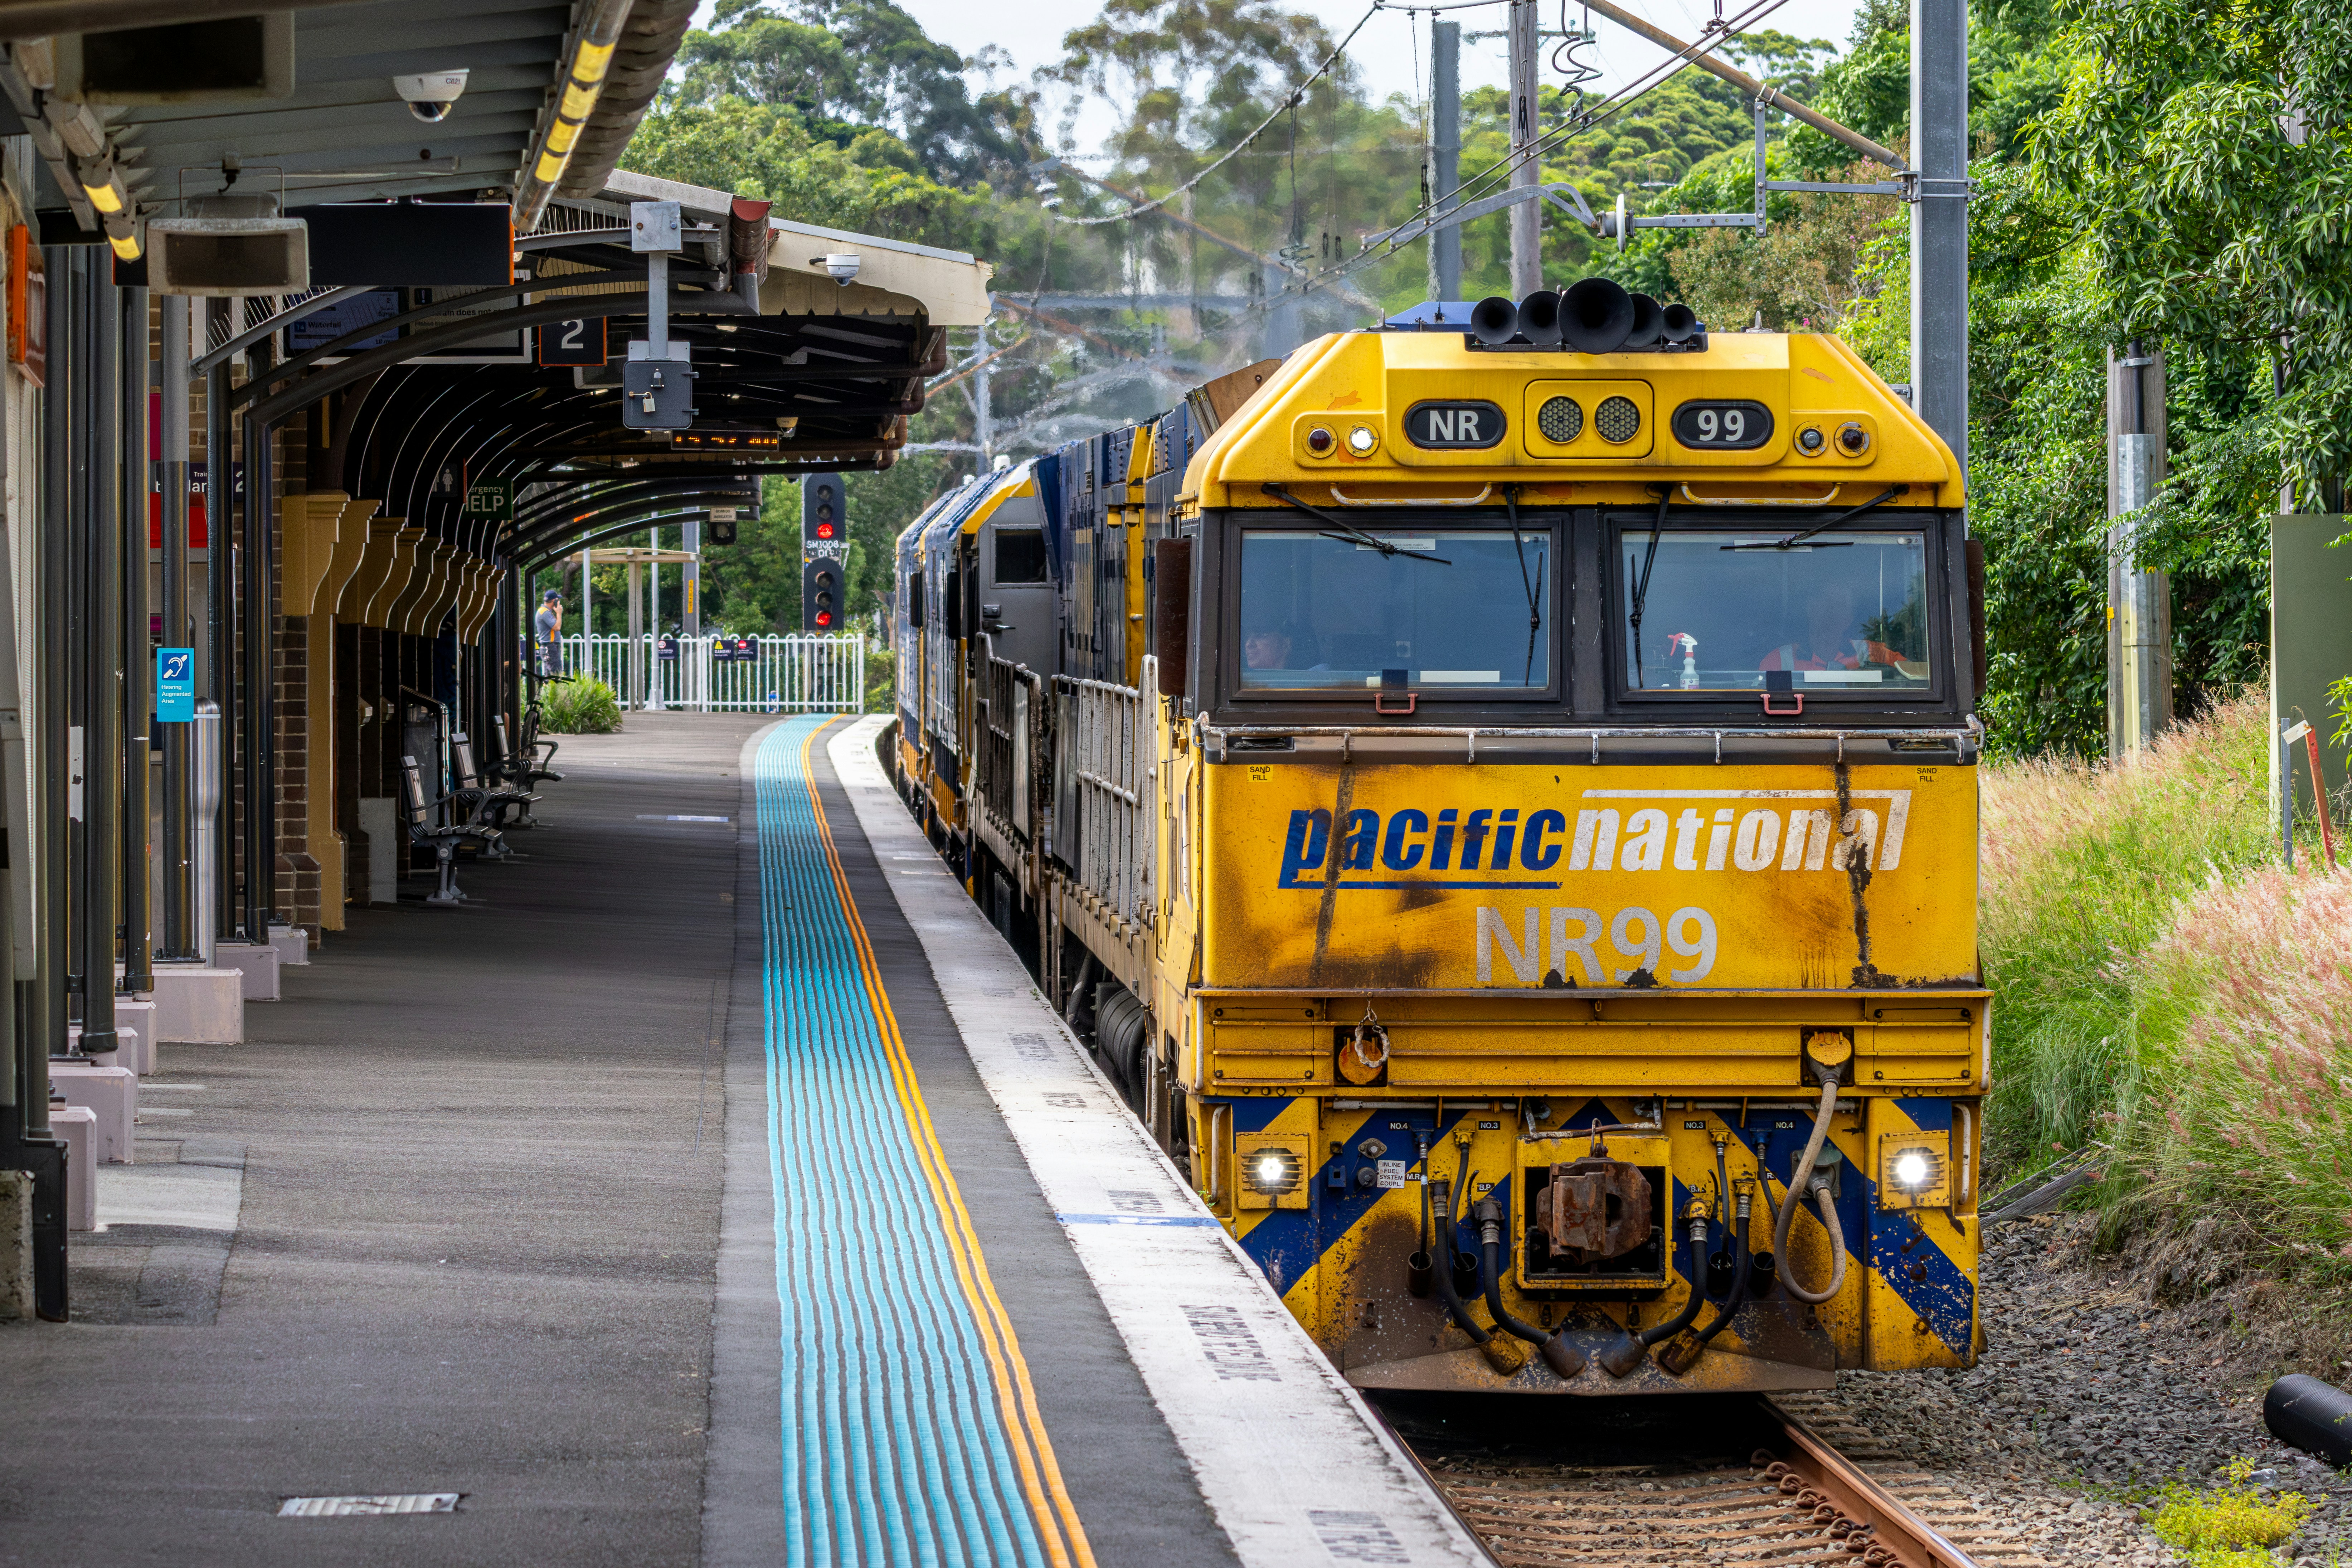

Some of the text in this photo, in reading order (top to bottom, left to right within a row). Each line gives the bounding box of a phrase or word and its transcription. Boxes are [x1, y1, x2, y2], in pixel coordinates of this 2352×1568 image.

[561, 319, 584, 349] 2
[1429, 410, 1480, 441] NR
[1697, 409, 1745, 441] 99
[1278, 789, 1911, 889] pacific national
[1476, 906, 1717, 983] NR99
